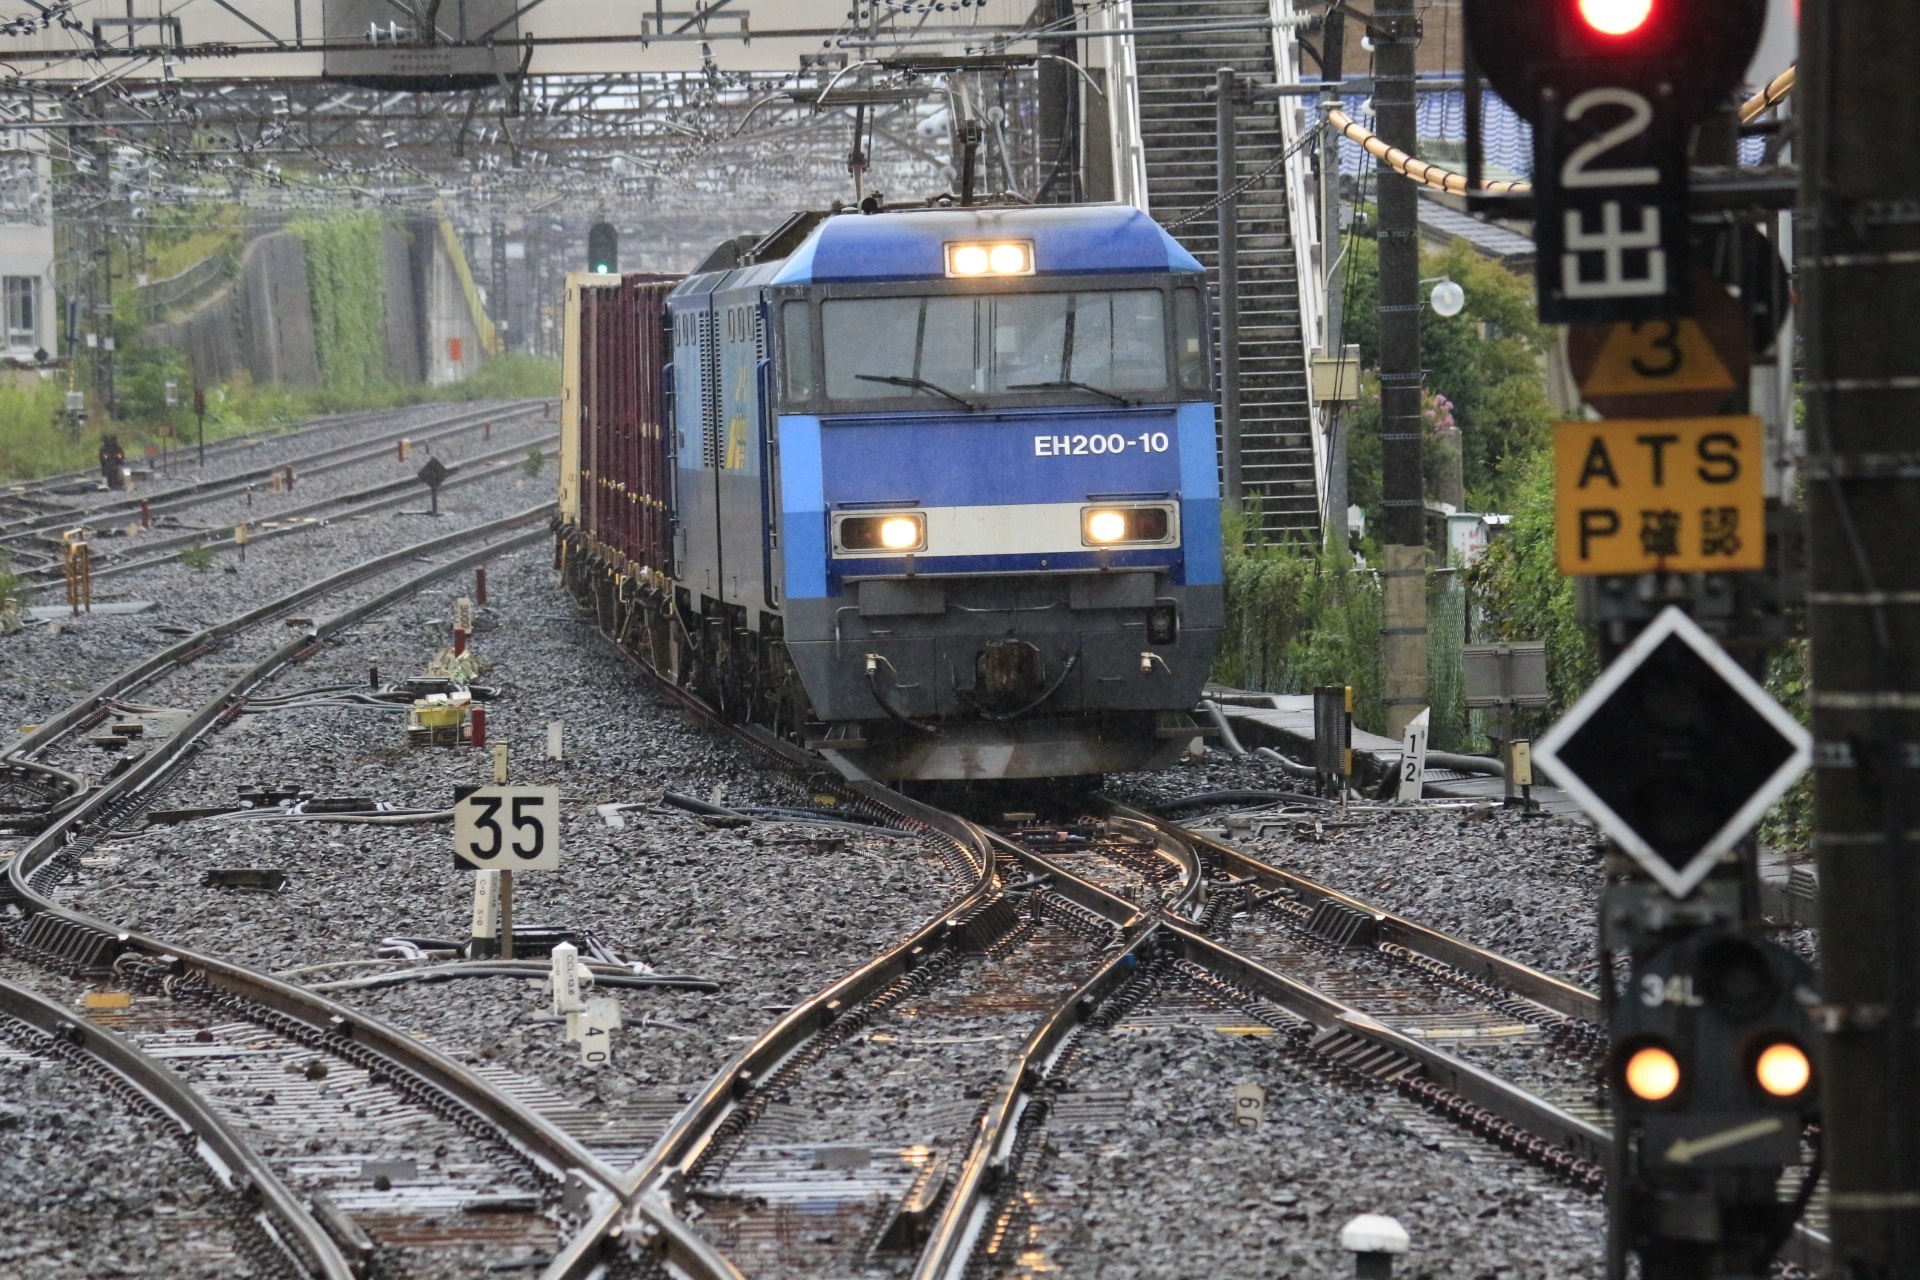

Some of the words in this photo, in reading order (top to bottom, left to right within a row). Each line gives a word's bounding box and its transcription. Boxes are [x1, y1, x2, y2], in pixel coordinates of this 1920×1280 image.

[1630, 319, 1683, 378] 3
[1034, 432, 1169, 456] EH200-10
[470, 796, 544, 860] 35
[1640, 973, 1704, 1008] 34L
